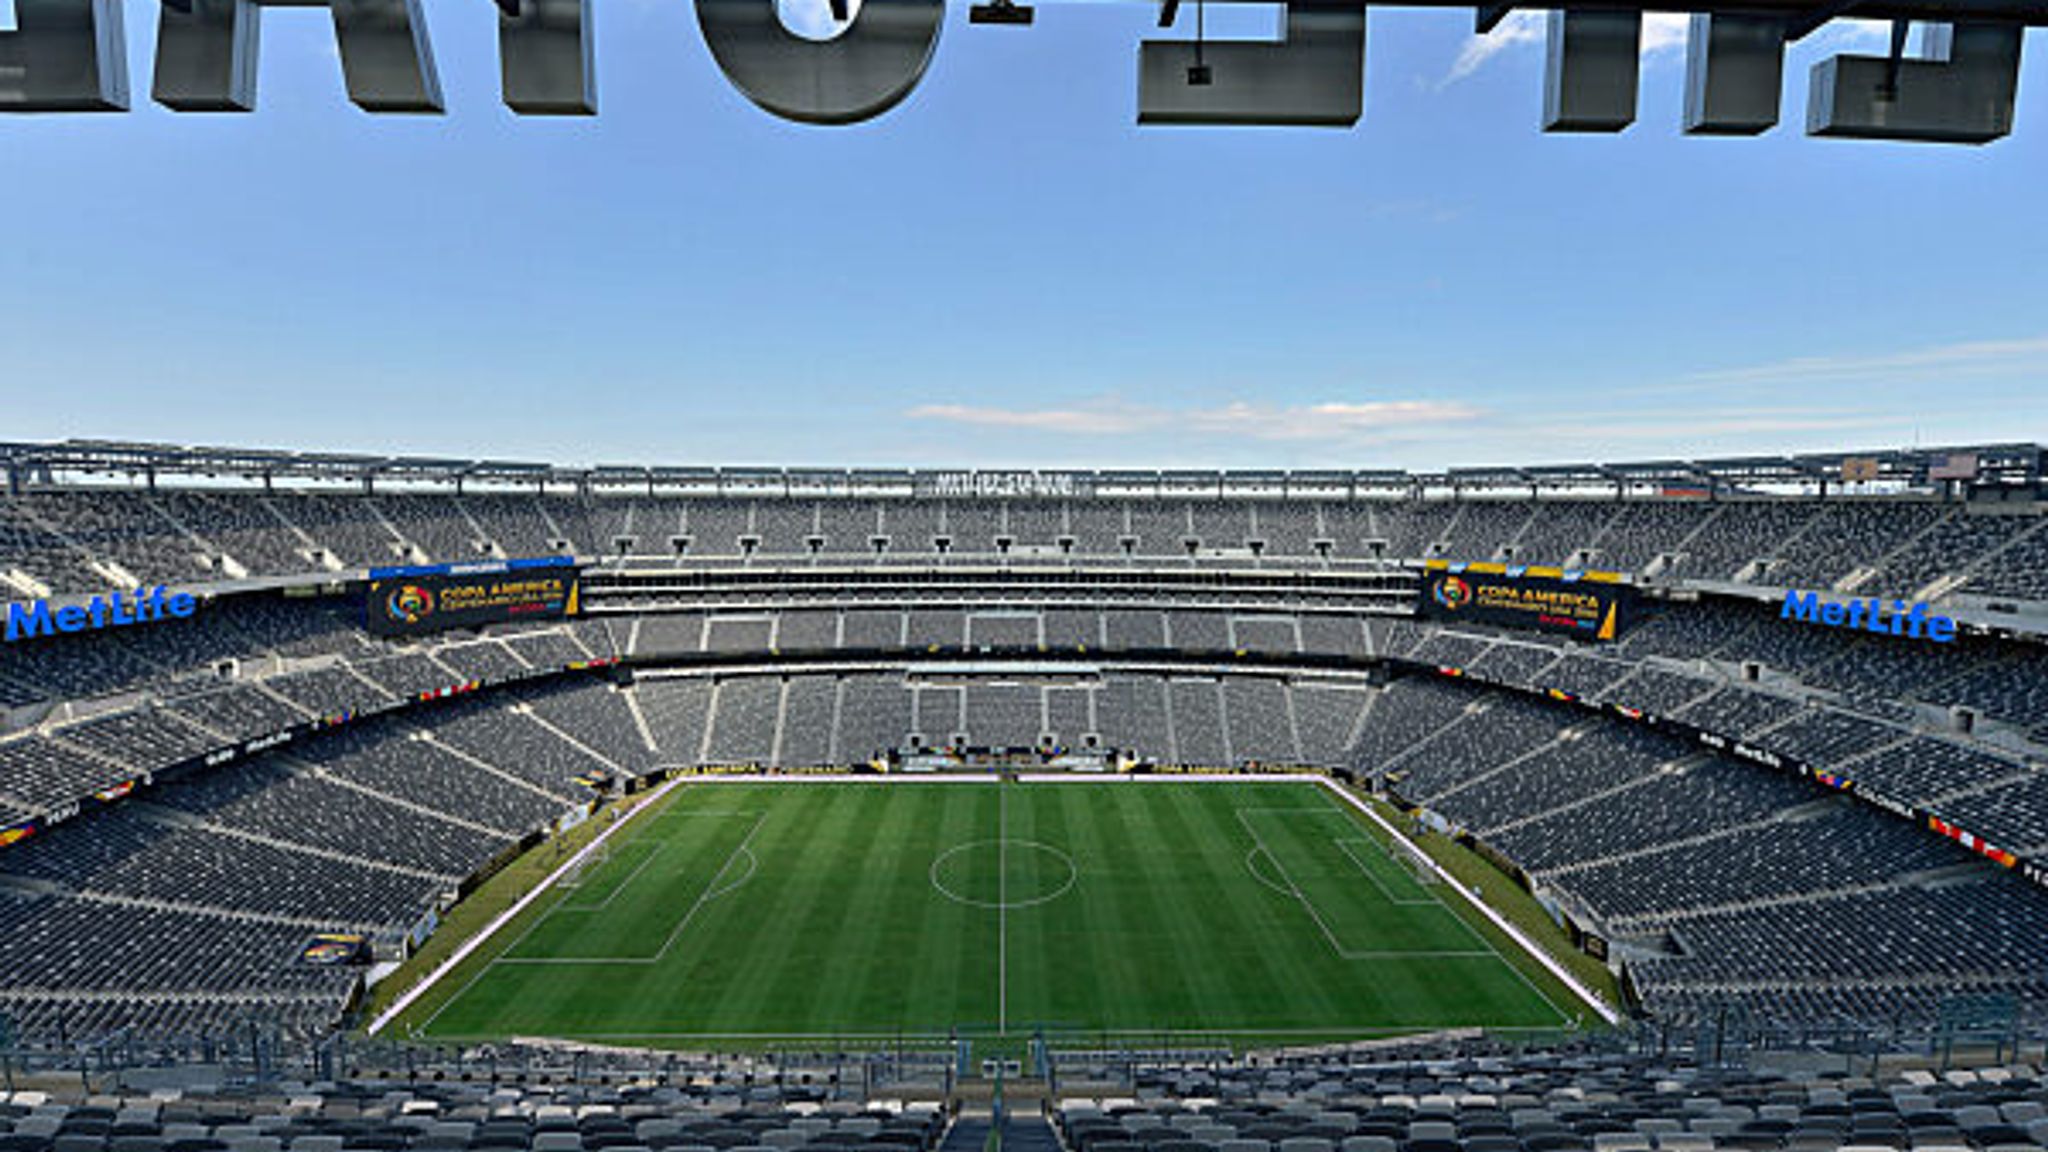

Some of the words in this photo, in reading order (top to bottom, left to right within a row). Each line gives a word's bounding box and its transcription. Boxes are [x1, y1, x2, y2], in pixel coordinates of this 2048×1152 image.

[6, 584, 197, 641] MetLife
[1478, 585, 1519, 600] COPA
[1523, 589, 1599, 609] AMERICA
[1780, 589, 1957, 642] MetLife
